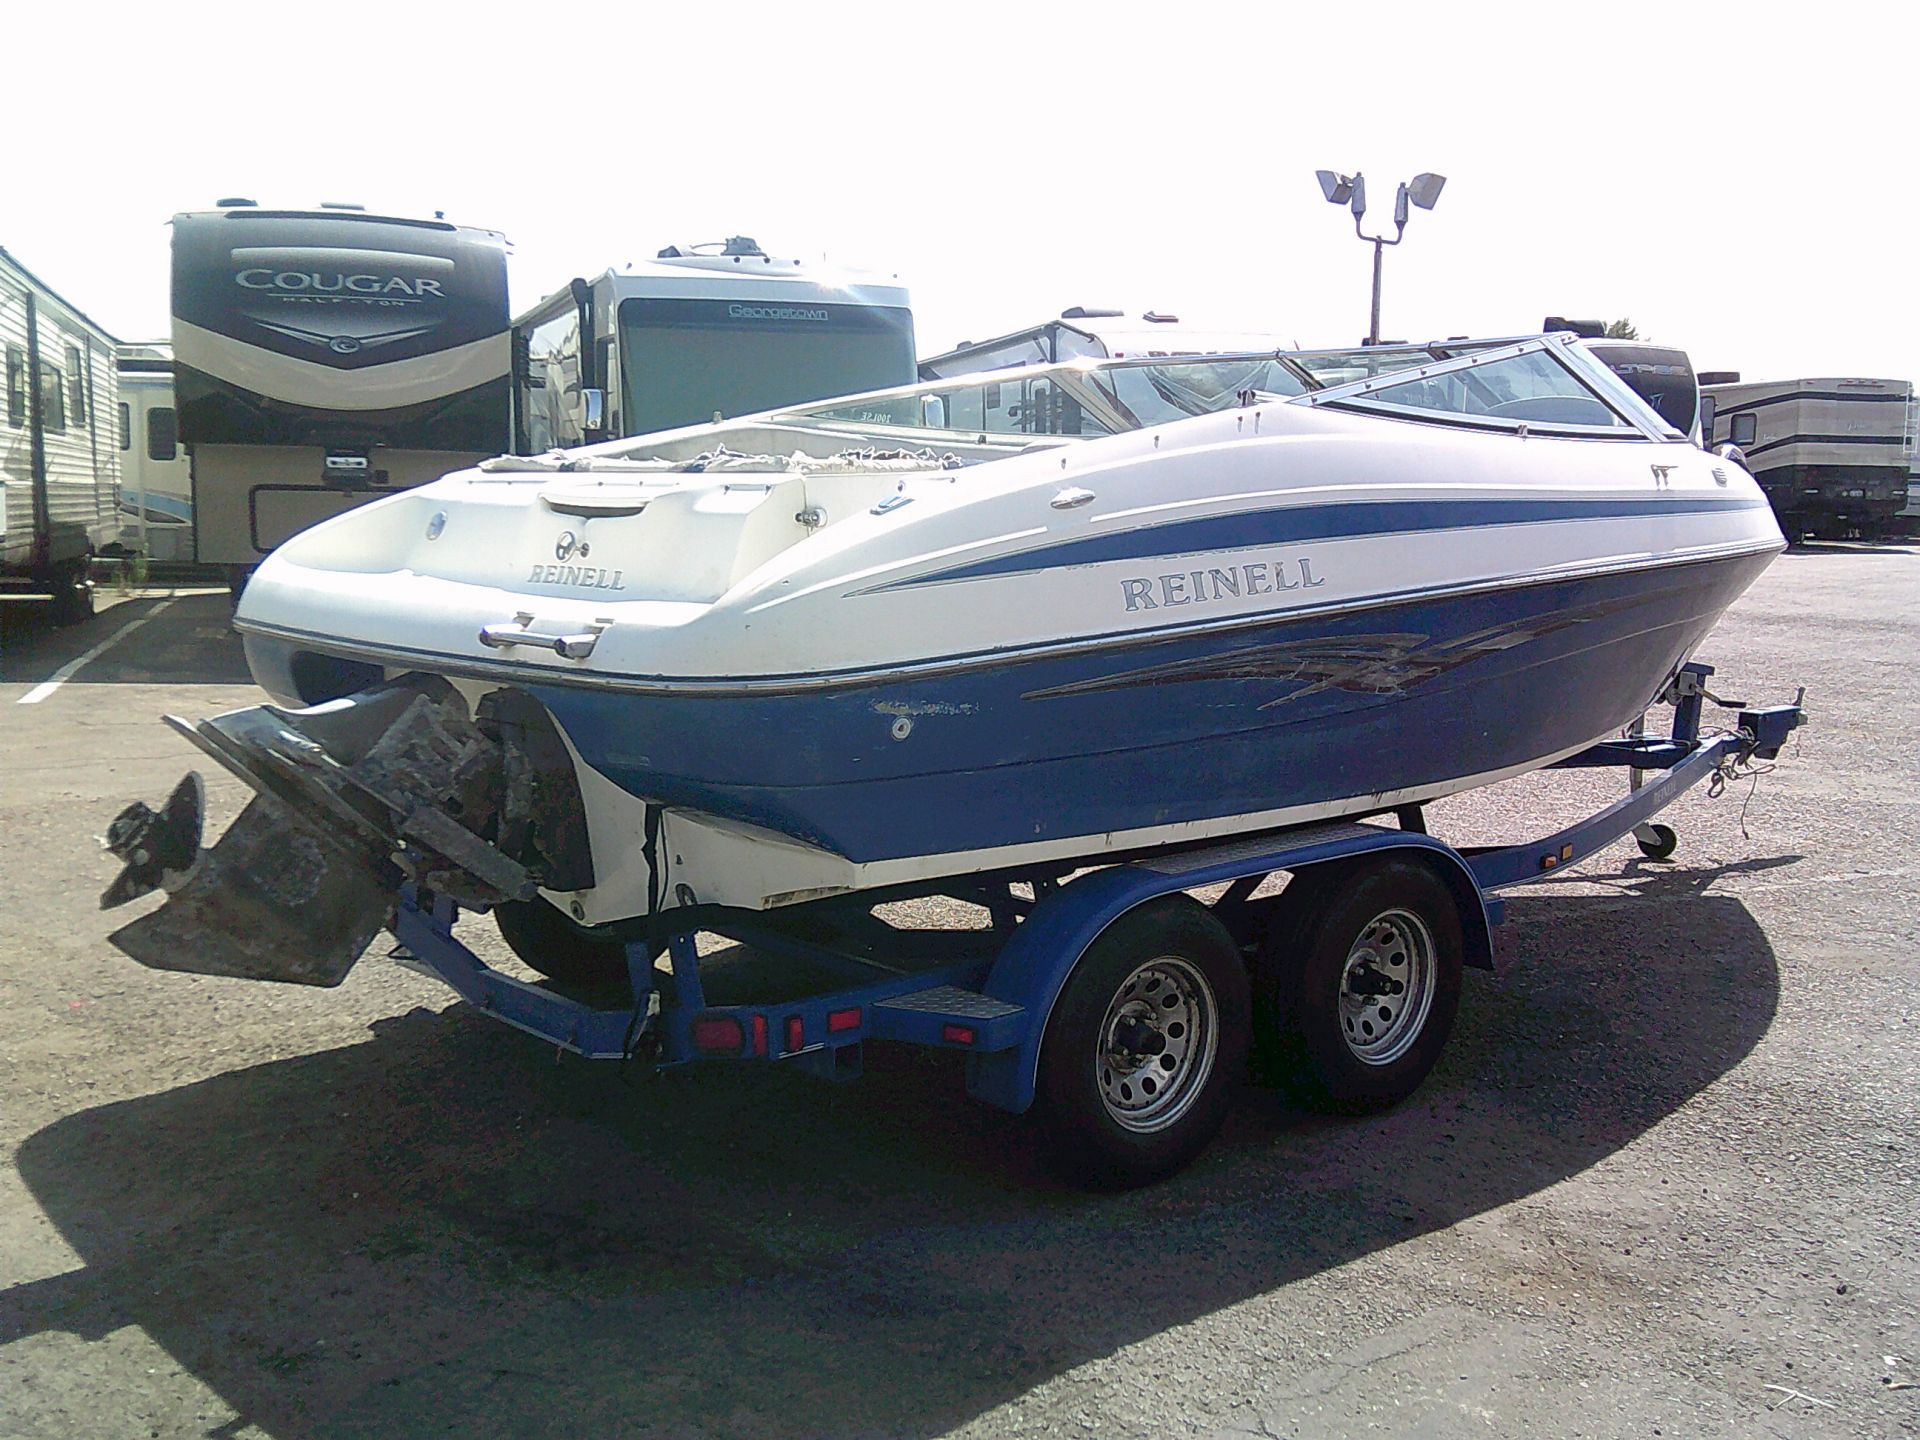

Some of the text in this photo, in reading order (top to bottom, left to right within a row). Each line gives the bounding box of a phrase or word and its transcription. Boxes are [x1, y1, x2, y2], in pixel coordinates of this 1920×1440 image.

[235, 268, 445, 297] COUGAR
[729, 303, 829, 320] Georgetown
[527, 564, 626, 590] REINELL
[1120, 558, 1325, 611] REINELL
